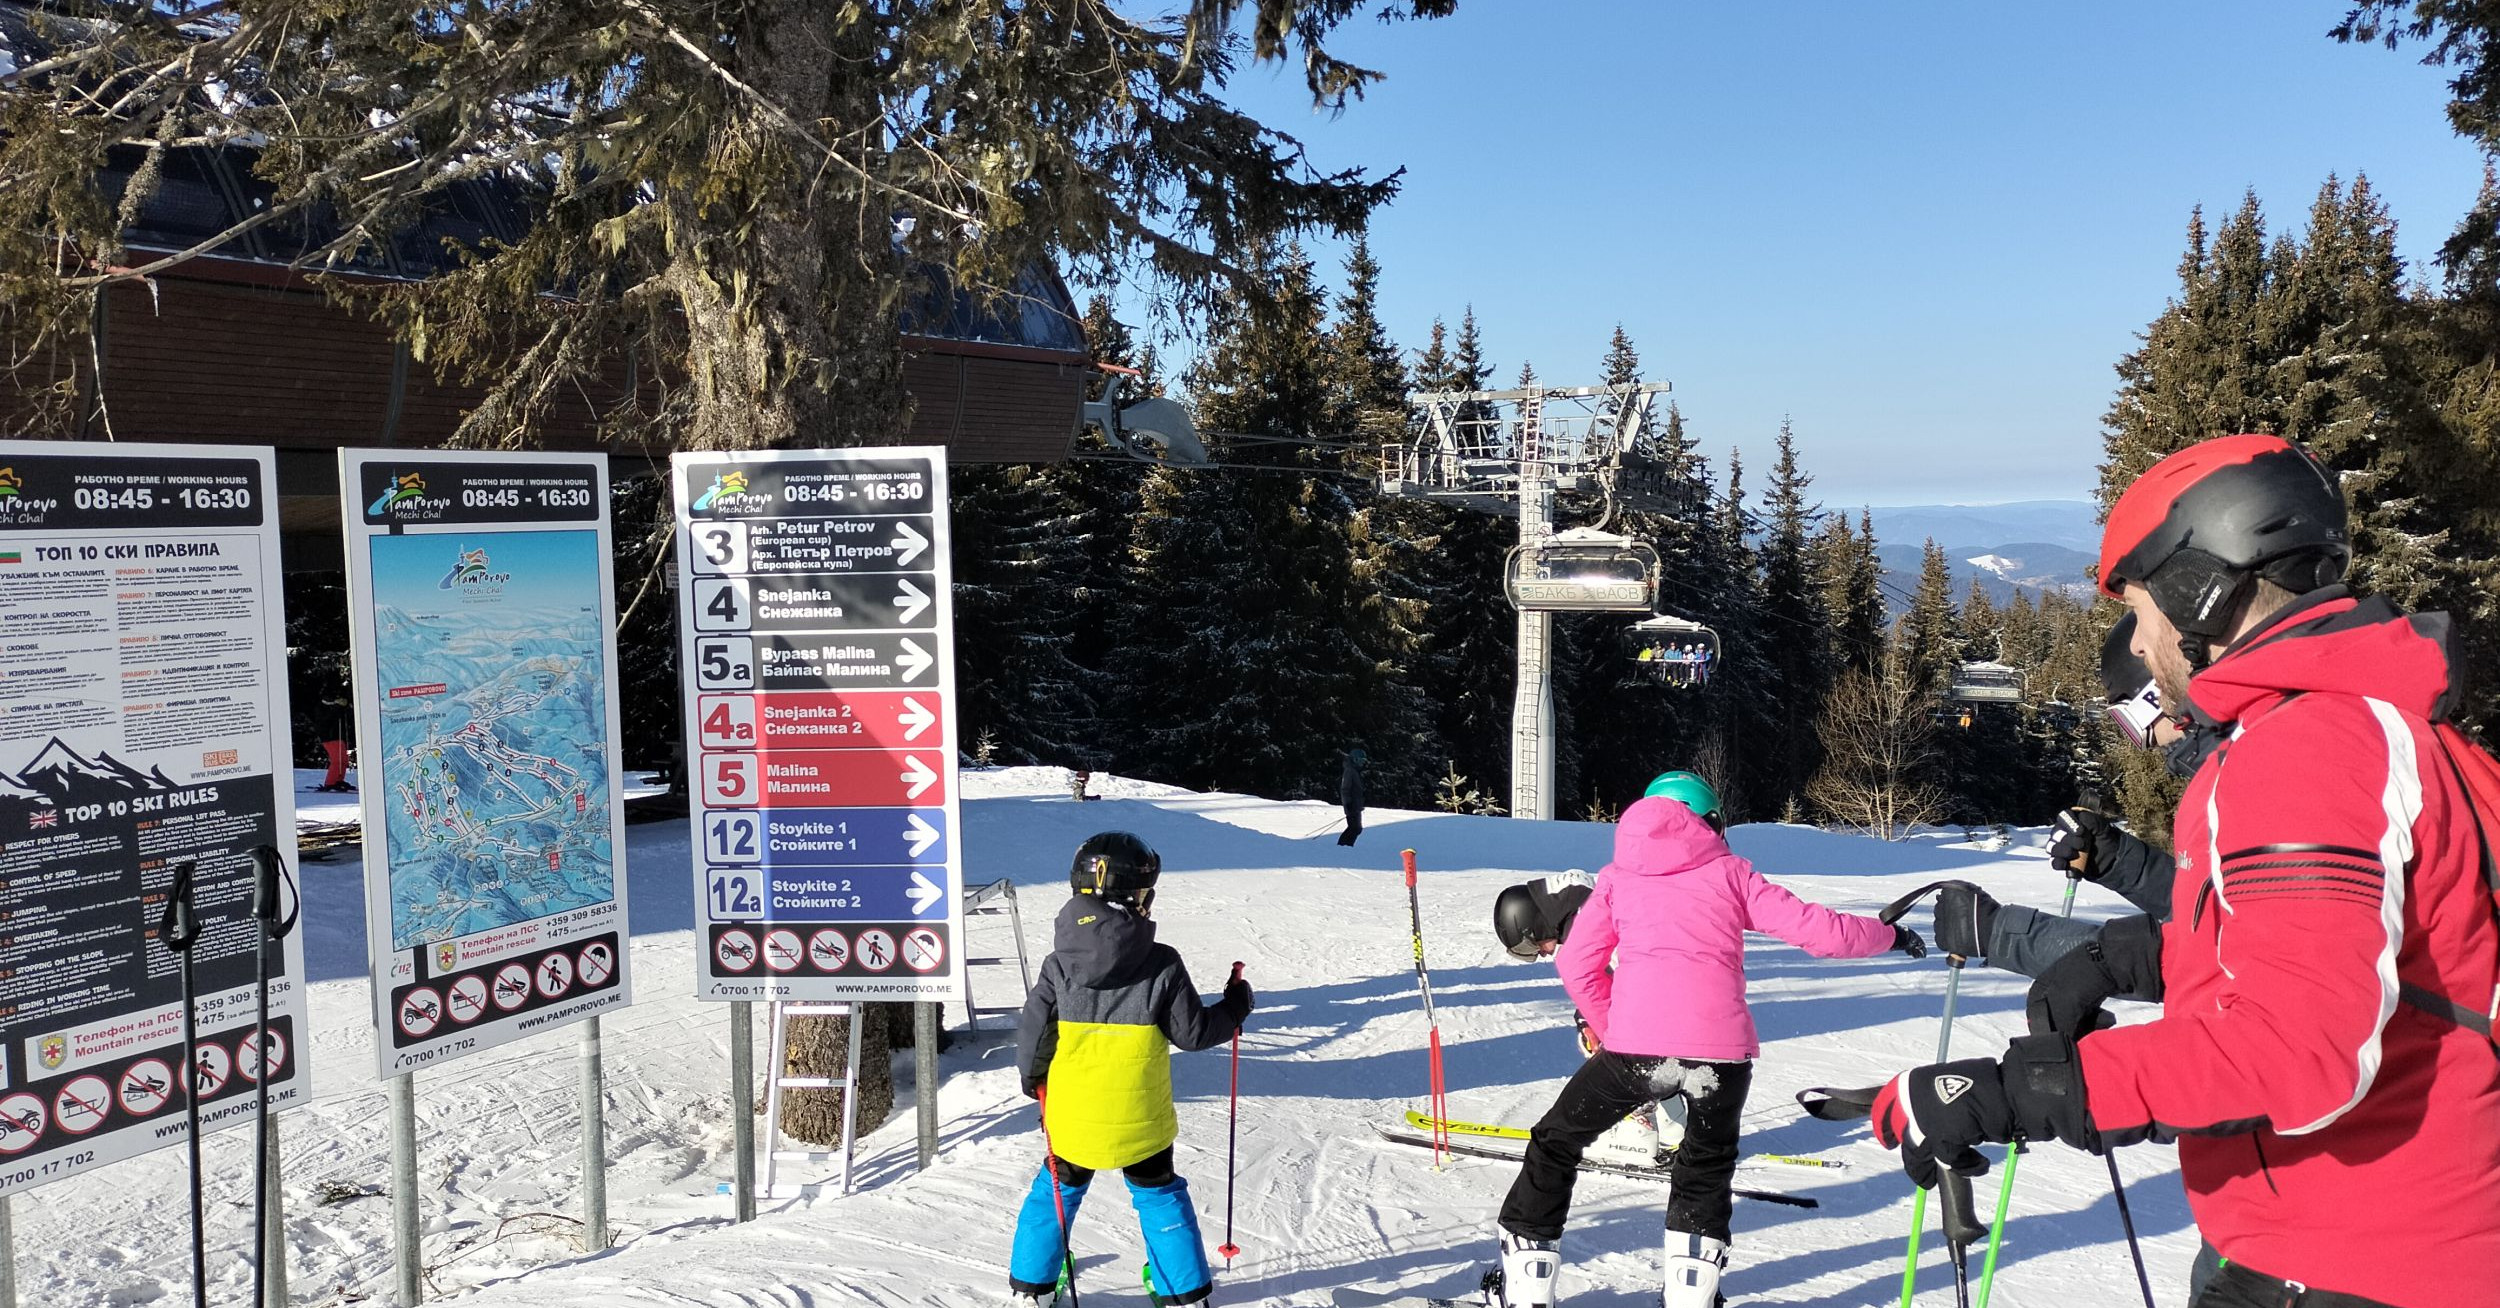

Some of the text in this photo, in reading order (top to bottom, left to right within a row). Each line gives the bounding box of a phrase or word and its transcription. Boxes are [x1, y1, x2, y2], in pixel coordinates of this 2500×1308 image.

[74, 475, 248, 485] РАБОТНО ВРЕМЕ WORKING HOURS
[462, 478, 498, 486] РАБОТНО
[855, 473, 892, 481] WORKING
[894, 472, 921, 480] HOURS
[74, 488, 152, 509] 08:45
[179, 489, 250, 509] 16:30
[462, 489, 519, 507] 08:45
[538, 489, 590, 506] 16:30
[784, 485, 844, 502] 08:45
[864, 483, 923, 500] 16:30
[395, 510, 441, 519] Mechi Chal
[718, 504, 763, 514] Mechi Chal
[18, 513, 44, 523] Chal
[751, 522, 875, 535] Arh. Petur Petrov
[705, 529, 734, 566] 3
[751, 535, 832, 547] (European cup)
[36, 542, 220, 561] ТОП 10 СКИ ПРАВИЛА
[752, 545, 893, 560] Арх. Петър Петров
[752, 559, 853, 571] (Европейска купа)
[707, 586, 738, 622] 4
[758, 589, 832, 605] Snejanka
[758, 605, 843, 619] Снежанка
[761, 646, 876, 663] Bypass Malina
[762, 662, 891, 677] Байпас Малина
[764, 705, 851, 721] Snejanka 2
[764, 722, 862, 735] Снежанка 2
[767, 764, 819, 777] Malina
[716, 760, 746, 798] 5
[767, 780, 831, 793] Малина
[65, 787, 219, 823] TOP 10 SKI RULES
[162, 814, 194, 826] PERSONAL
[769, 822, 847, 837] Stoykite 1
[5, 833, 80, 851] RESPECT FOR OTHERS
[712, 819, 755, 856] 12
[770, 838, 857, 851] Стойките 1
[9, 869, 77, 887] CONTROL OF SPEED
[772, 880, 852, 895] Stoykite 2
[772, 895, 861, 909] Стойките 2
[11, 905, 48, 918] JUMPING
[545, 903, 618, 928] +359 309 58336
[14, 929, 59, 943] OVERTAKING
[461, 923, 540, 950] Телефон на ПСС
[547, 926, 570, 939] 1475
[461, 936, 537, 961] Mountain rescue
[16, 960, 53, 975] STOPPING
[54, 958, 66, 967] ON
[82, 950, 104, 961] SLOPE
[721, 986, 790, 995] 0700 17 702
[835, 984, 953, 994] WWW.PAMPOROVO.ME
[227, 990, 251, 1006] 309
[518, 993, 622, 1031] WWW.PAMPOROVO.ME
[74, 1009, 183, 1046] Телефон на ПСС
[74, 1025, 180, 1059] Mountain rescue
[405, 1038, 476, 1066] 0700 17 702
[1609, 1143, 1648, 1154] HEAD
[41, 1150, 95, 1175] 17 702
